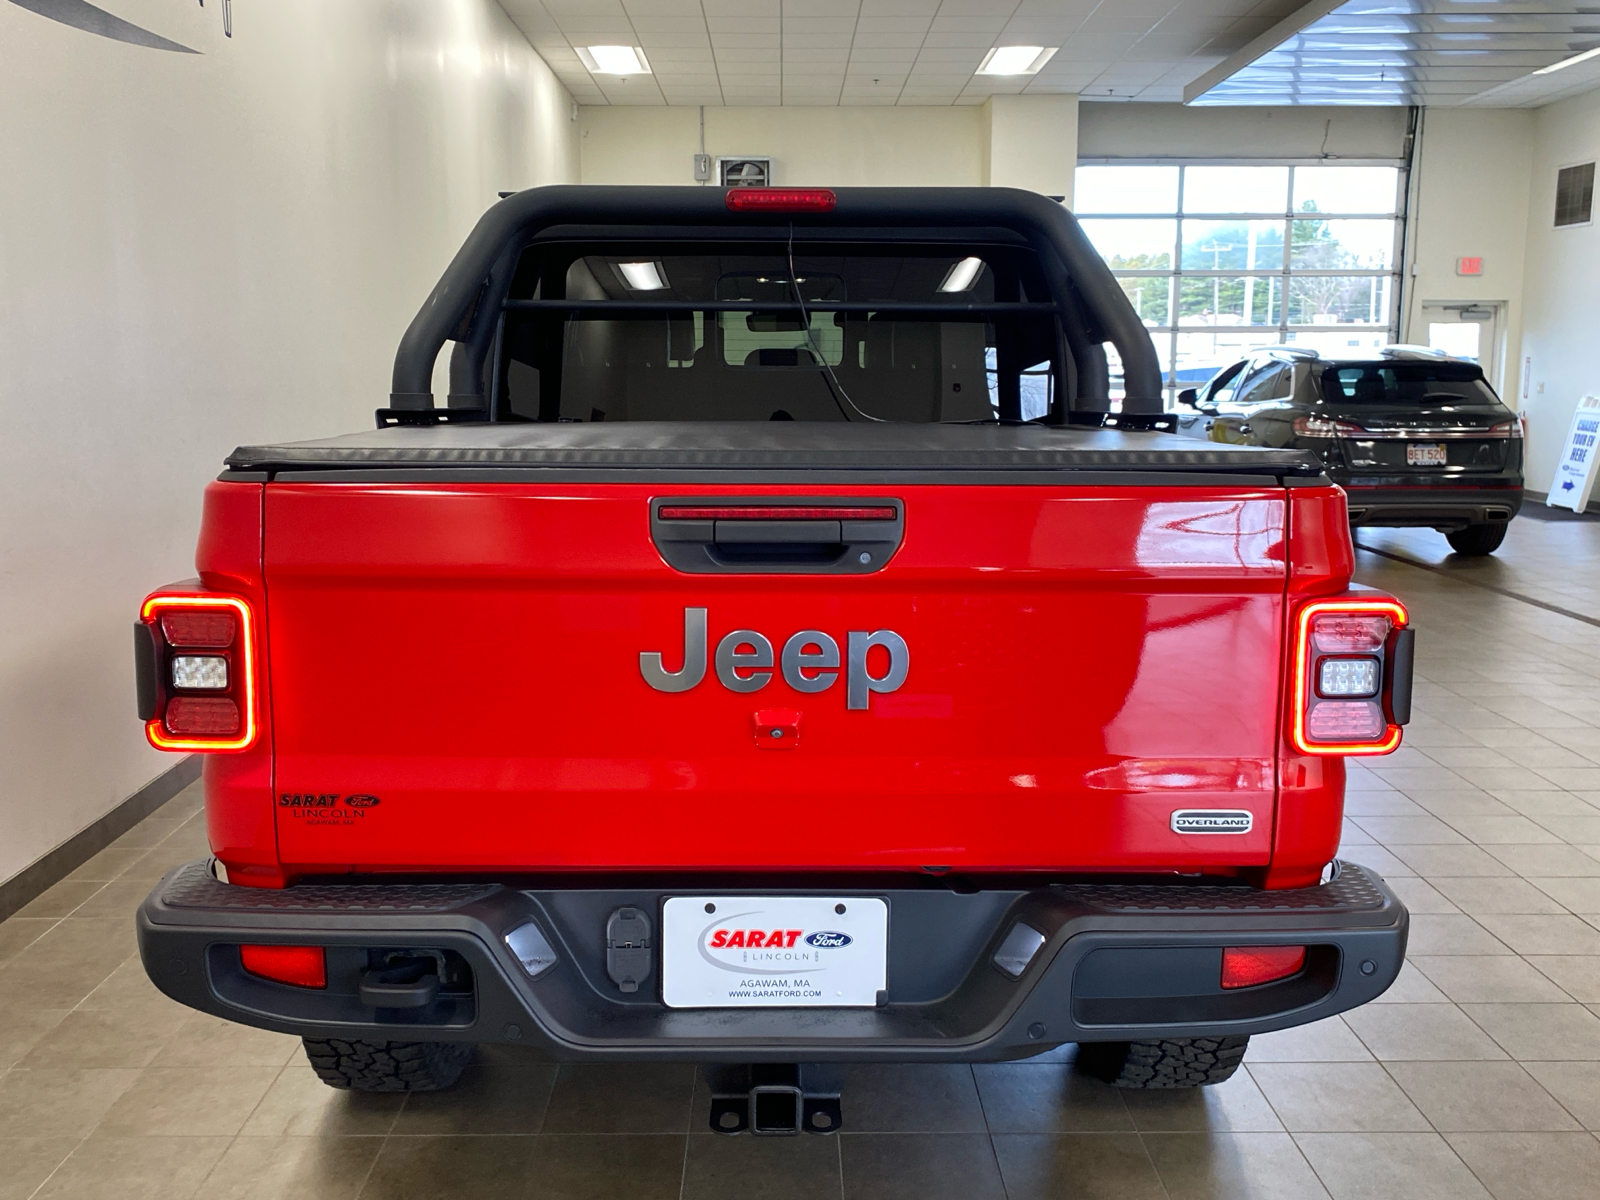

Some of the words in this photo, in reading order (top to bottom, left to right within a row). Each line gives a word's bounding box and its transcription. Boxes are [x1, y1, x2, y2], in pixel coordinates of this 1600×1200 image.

[1577, 419, 1599, 433] CHARGE
[1572, 433, 1588, 446] YOUR
[1586, 435, 1596, 447] EV
[1570, 448, 1588, 463] HERE
[639, 607, 910, 710] Jeep
[280, 793, 340, 807] SARAT
[293, 809, 365, 818] LINCOLN
[709, 929, 804, 949] SARAT
[812, 932, 845, 948] Ford
[752, 952, 810, 961] LINCOLN
[739, 979, 791, 989] AGAWAM,
[793, 979, 811, 988] MA
[728, 990, 822, 998] WWW.SARATFORD.COM
